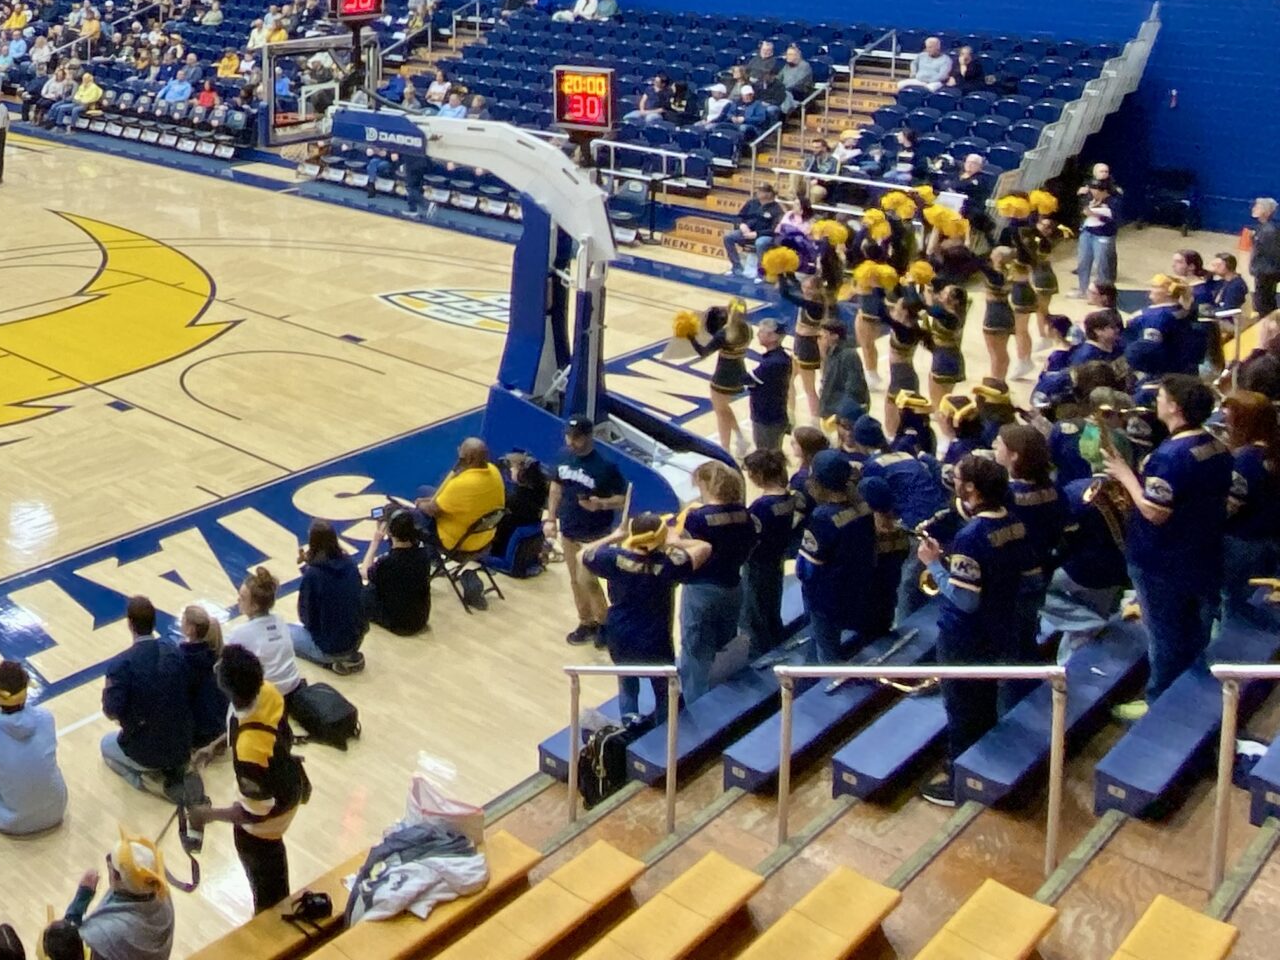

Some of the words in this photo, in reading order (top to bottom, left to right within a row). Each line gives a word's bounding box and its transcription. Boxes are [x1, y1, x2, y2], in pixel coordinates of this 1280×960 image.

[563, 74, 606, 97] 20:00
[572, 95, 599, 118] 30
[677, 223, 714, 235] GOLDEN
[663, 237, 696, 251] KENT
[701, 245, 725, 258] STA
